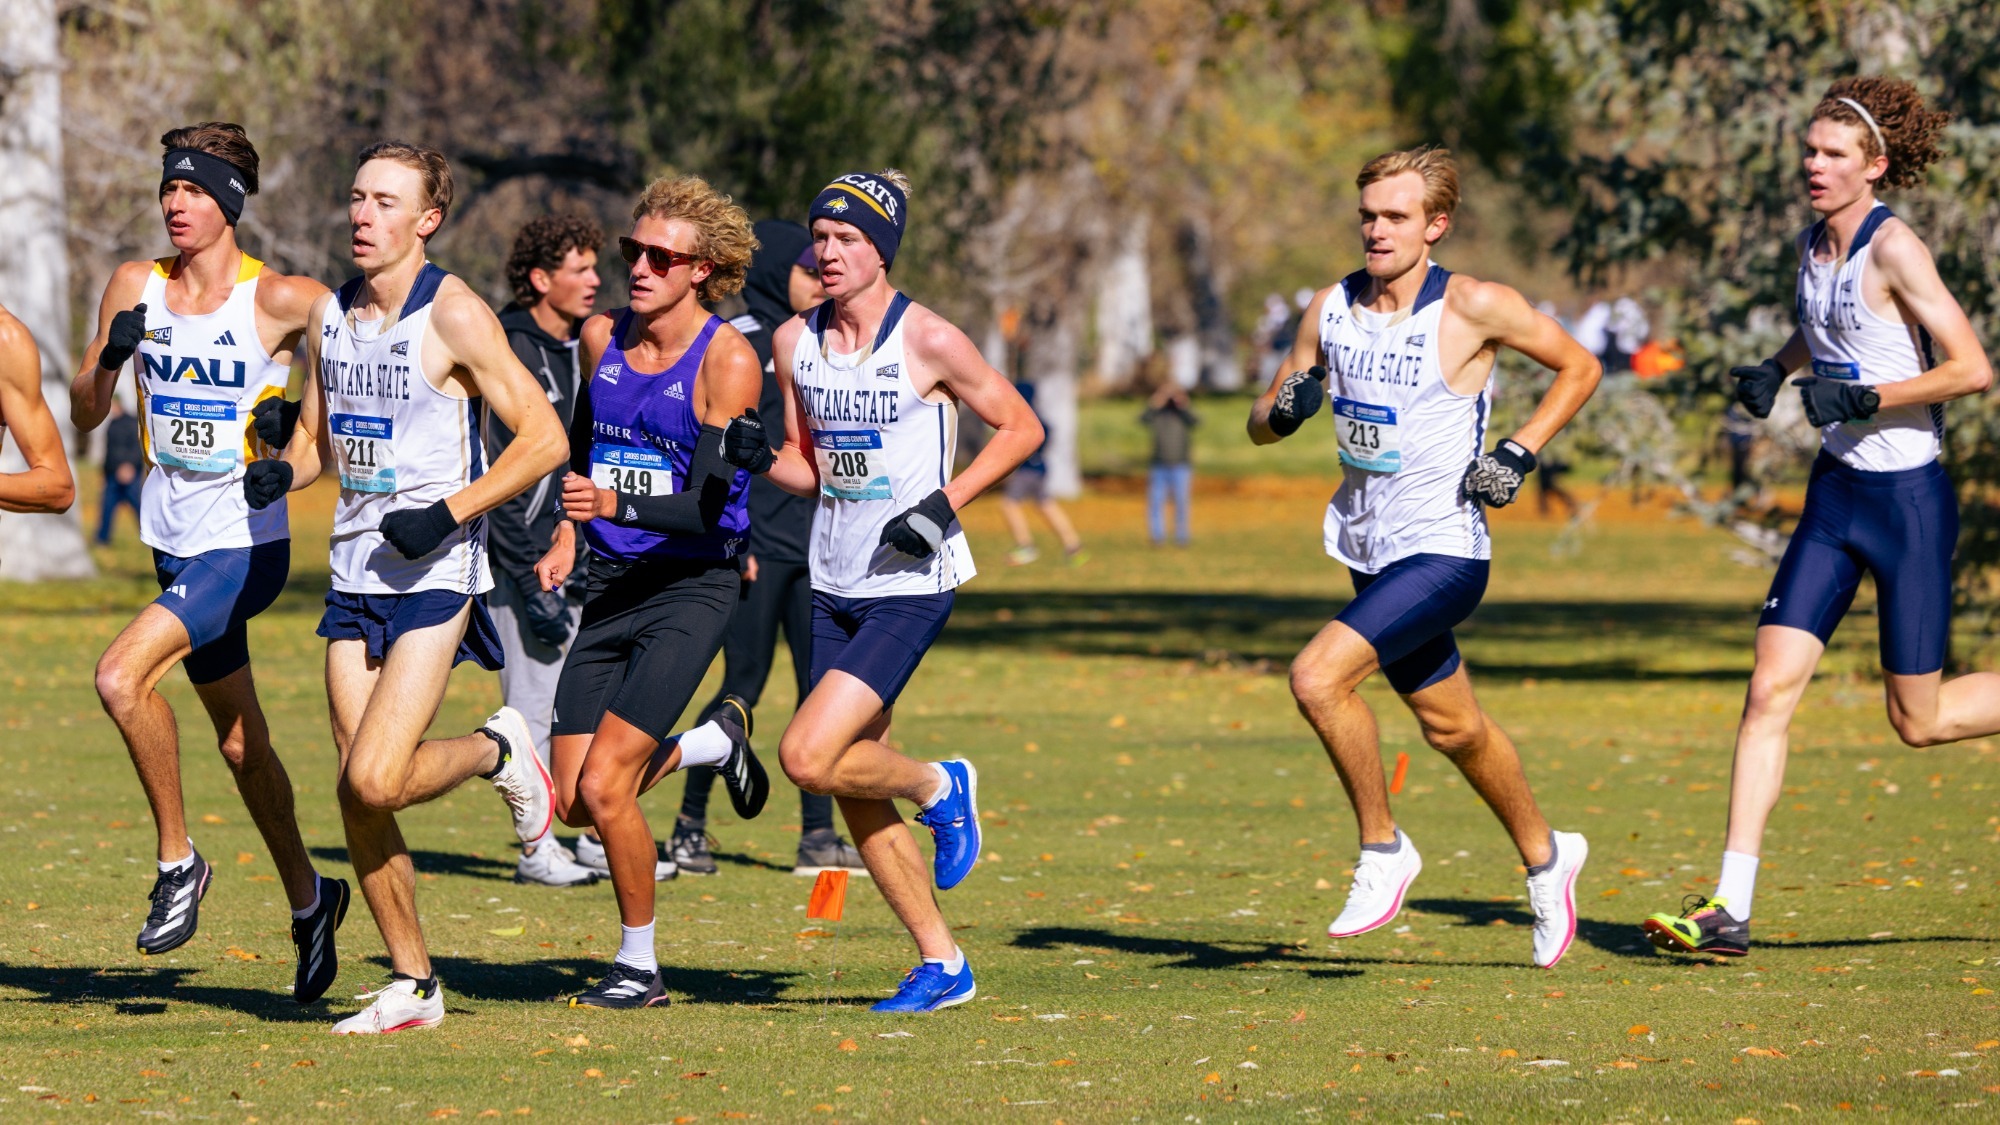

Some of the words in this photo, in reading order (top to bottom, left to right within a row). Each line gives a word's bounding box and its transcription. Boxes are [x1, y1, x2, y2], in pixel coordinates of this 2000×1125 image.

[140, 352, 246, 388] NAU
[377, 363, 410, 400] STATE
[1379, 352, 1423, 387] STATE
[184, 403, 201, 412] CROSS
[201, 404, 226, 413] COUNTRY
[663, 389, 686, 401] adidas
[854, 390, 899, 424] STATE
[170, 418, 215, 448] 253
[640, 430, 680, 452] STATE
[1347, 420, 1380, 449] 213
[345, 437, 377, 467] 211
[623, 451, 640, 460] CROSS
[640, 452, 663, 463] COUNTRY
[828, 451, 869, 477] 208
[609, 467, 652, 496] 349
